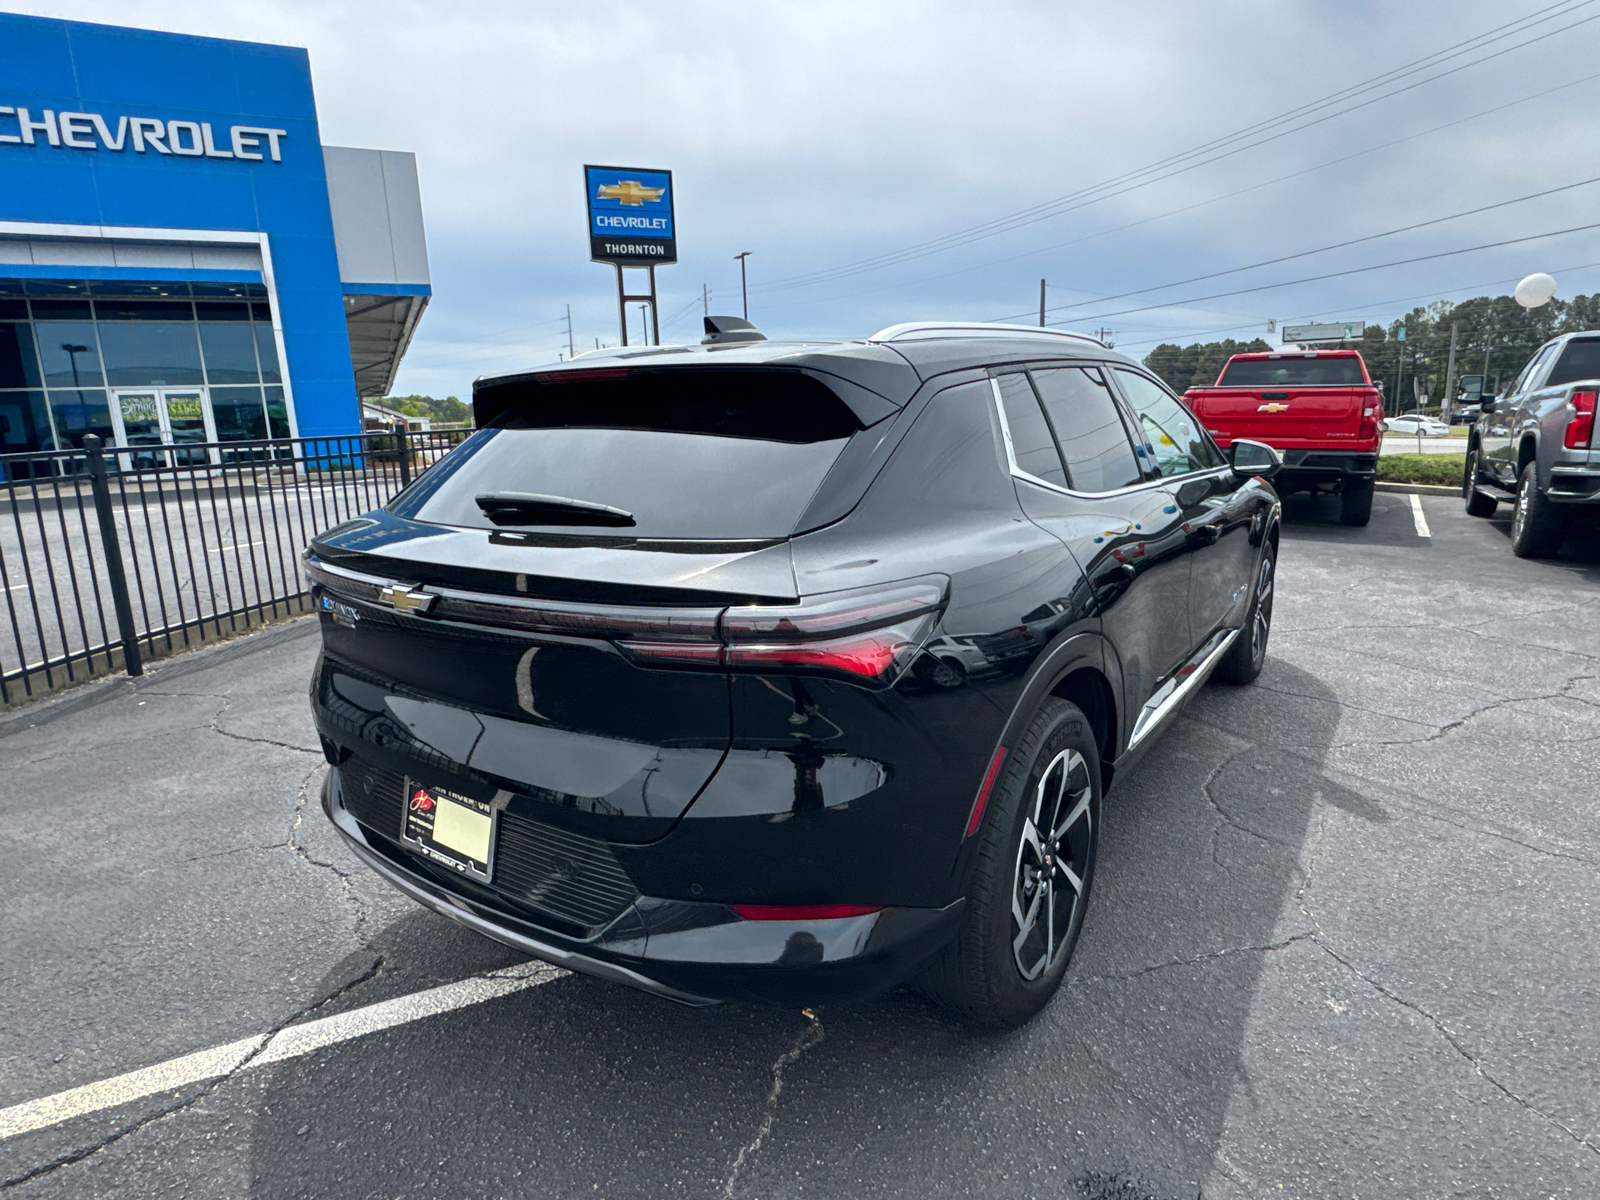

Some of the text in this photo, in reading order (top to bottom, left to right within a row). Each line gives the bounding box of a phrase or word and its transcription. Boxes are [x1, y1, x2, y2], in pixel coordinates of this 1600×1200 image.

[0, 106, 287, 161] CHEVROLET
[596, 215, 668, 229] CHEVROLET
[604, 243, 664, 255] THORNTON
